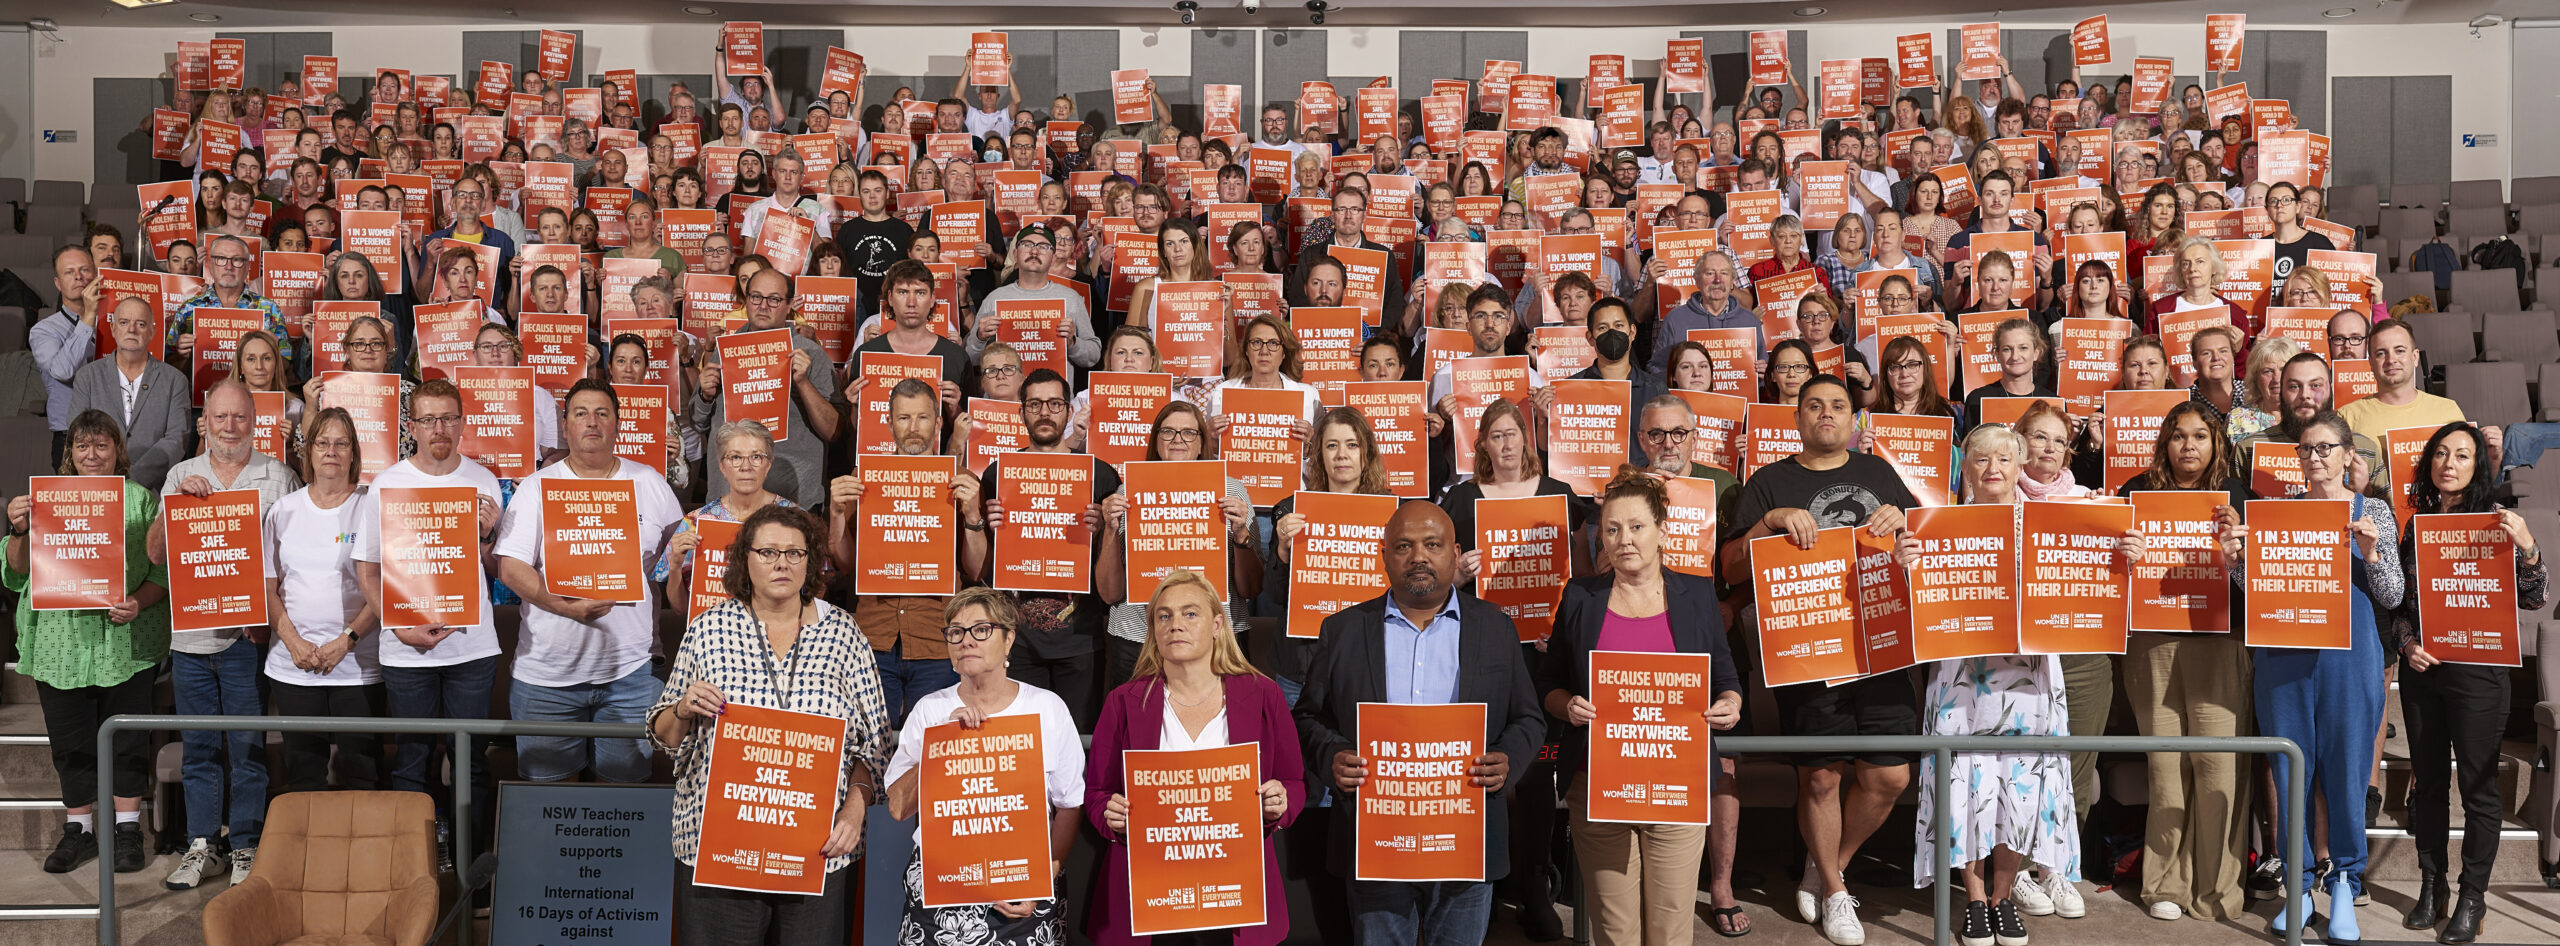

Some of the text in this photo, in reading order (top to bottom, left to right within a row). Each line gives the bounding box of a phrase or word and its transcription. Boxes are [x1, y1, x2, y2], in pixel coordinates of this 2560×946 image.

[1821, 174, 1844, 182] WOMEN
[1807, 182, 1841, 190] EXPERIENCE
[1803, 197, 1846, 205] THEIR LIFETIME.
[1160, 291, 1219, 301] BECAUSE WOMEN
[1171, 301, 1209, 311] SHOULD BE
[419, 310, 477, 323] BECAUSE WOMEN
[1179, 312, 1199, 321] SAFE.
[431, 321, 469, 332] SHOULD BE
[1164, 322, 1214, 332] EVERYWHERE.
[2065, 328, 2126, 339] BECAUSE WOMEN
[441, 331, 460, 342] SAFE.
[1172, 332, 1205, 342] ALWAYS.
[723, 340, 786, 357] BECAUSE WOMEN
[2076, 339, 2115, 349] SHOULD BE
[737, 354, 777, 369] SHOULD BE
[2084, 350, 2104, 360] SAFE.
[2068, 360, 2119, 371] EVERYWHERE.
[747, 368, 767, 380] SAFE.
[2076, 371, 2109, 381] ALWAYS.
[732, 378, 783, 394] EVERYWHERE.
[743, 390, 775, 404] ALWAYS.
[1820, 485, 1861, 500] CRONULLA
[170, 503, 253, 520] BECAUSE WOMEN
[188, 518, 241, 534] SHOULD BE
[200, 534, 228, 548] SAFE.
[2422, 529, 2507, 543] BECAUSE WOMEN
[180, 547, 250, 564] EVERYWHERE.
[2440, 546, 2494, 559] SHOULD BE
[194, 563, 239, 578] ALWAYS.
[1762, 557, 1846, 580] 1 IN 3 WOMEN
[2452, 562, 2480, 575] SAFE.
[1770, 574, 1841, 596] EXPERIENCE
[2431, 578, 2502, 591] EVERYWHERE.
[1770, 591, 1841, 613] VIOLENCE IN
[2444, 594, 2490, 608] ALWAYS.
[1763, 606, 1855, 629] THEIR LIFETIME.
[1598, 669, 1701, 687] BECAUSE WOMEN
[1618, 688, 1683, 704] SHOULD BE
[1632, 706, 1665, 722] SAFE.
[722, 721, 836, 752] BECAUSE WOMEN
[1606, 723, 1692, 741] EVERYWHERE.
[981, 733, 1033, 753] WOMEN
[1369, 740, 1471, 758] 1 IN 3 WOMEN
[1620, 741, 1676, 758] ALWAYS.
[742, 745, 814, 769] SHOULD BE
[944, 754, 1016, 776] SHOULD BE
[1377, 759, 1463, 777] EXPERIENCE
[754, 766, 791, 786] SAFE.
[1133, 765, 1250, 786] BECAUSE WOMEN
[961, 776, 998, 795] SAFE.
[1375, 779, 1461, 796] VIOLENCE IN
[1652, 783, 1665, 791] SAFE
[723, 782, 816, 809] EVERYWHERE.
[1157, 785, 1232, 804] SHOULD BE
[1602, 790, 1634, 798] WOMEN
[1652, 791, 1687, 799] EVERYWHERE
[934, 793, 1028, 818] EVERYWHERE.
[1364, 797, 1475, 816] THEIR LIFETIME.
[543, 807, 645, 822] NSW Teachers
[737, 804, 797, 827] ALWAYS.
[1175, 805, 1213, 823] SAFE.
[555, 824, 630, 838] Federation
[952, 814, 1013, 836] ALWAYS.
[1146, 822, 1243, 844] EVERYWHERE.
[1374, 839, 1404, 847] WOMEN
[1422, 839, 1455, 847] EVERYWHERE
[560, 846, 623, 860] supports
[734, 849, 747, 857] UN
[766, 852, 782, 860] SAFE
[1164, 842, 1227, 861] ALWAYS.
[712, 853, 746, 865] WOMEN
[765, 860, 804, 871] EVERYWHERE
[989, 860, 1004, 868] SAFE
[579, 865, 602, 878] the
[780, 867, 804, 877] ALWAYS
[959, 866, 972, 874] UN
[990, 866, 1029, 877] EVERYWHERE
[938, 874, 972, 882] WOMEN
[1006, 873, 1030, 883] ALWAYS
[545, 885, 634, 900] International
[1168, 888, 1181, 896] UN
[1201, 885, 1216, 893] SAFE
[1202, 891, 1240, 901] EVERYWHERE
[1146, 895, 1181, 906] WOMEN
[1218, 899, 1242, 907] ALWAYS
[518, 905, 659, 922] 16 Days of Activism
[561, 924, 614, 940] against
